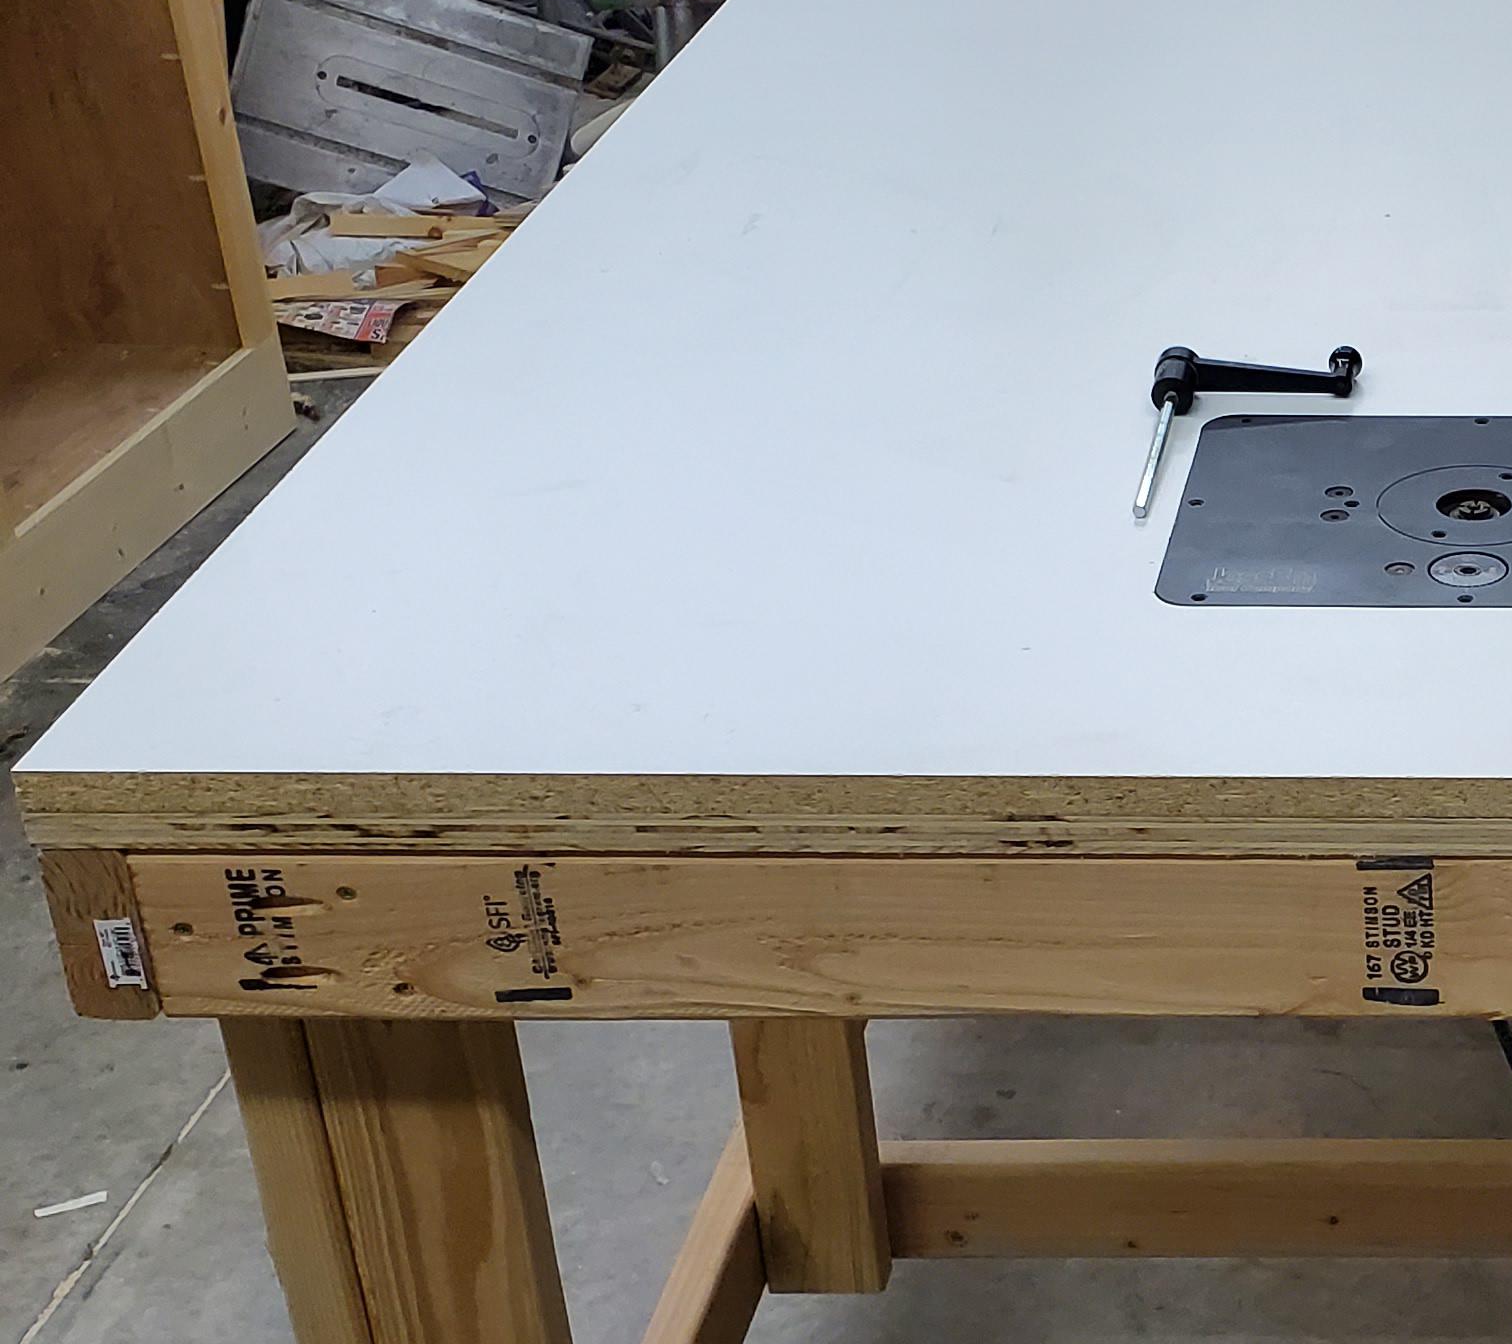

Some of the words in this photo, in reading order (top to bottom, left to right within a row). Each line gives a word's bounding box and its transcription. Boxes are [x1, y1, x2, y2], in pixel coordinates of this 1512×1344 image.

[1363, 886, 1380, 948] STIMSON
[1381, 904, 1402, 949] STUD
[1418, 909, 1434, 927] HT
[1420, 930, 1435, 949] KD
[1366, 954, 1383, 980] 167
